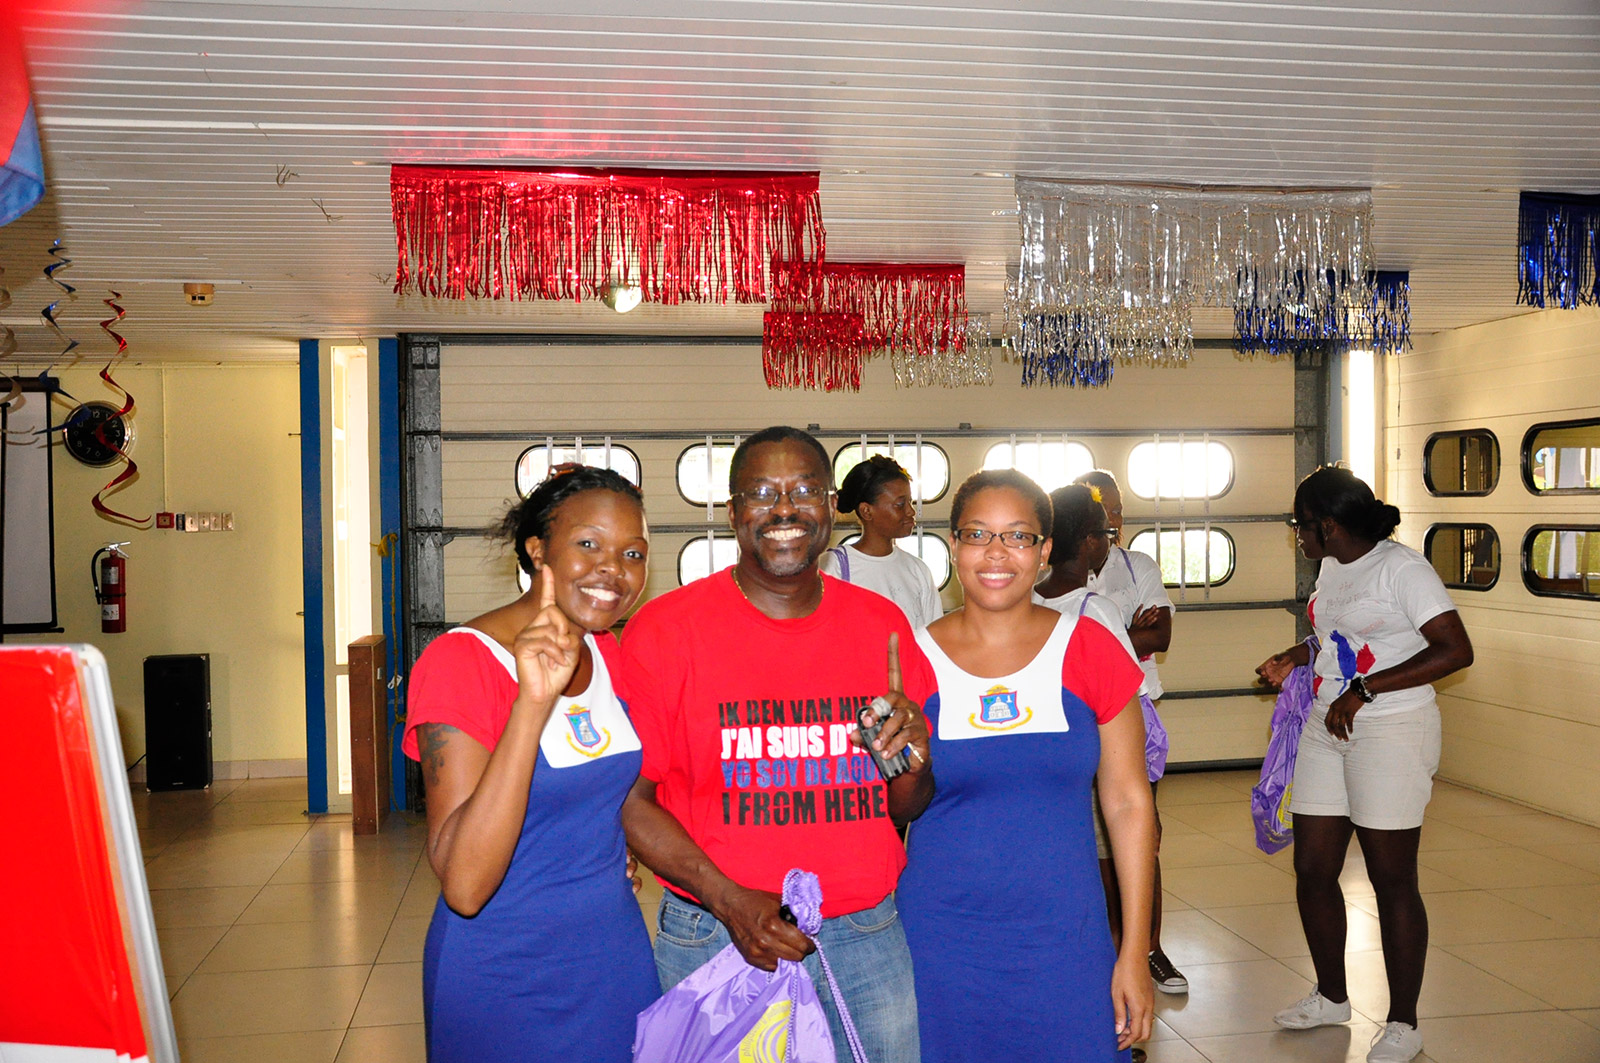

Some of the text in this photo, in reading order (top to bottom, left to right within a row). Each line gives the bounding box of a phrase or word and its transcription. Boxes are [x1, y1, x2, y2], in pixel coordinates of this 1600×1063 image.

[718, 701, 741, 727] IK
[746, 698, 786, 726] BEN
[789, 697, 833, 724] VAN
[721, 727, 762, 759] J'AI
[766, 725, 825, 759] SUIS
[721, 755, 884, 789] YO SOY DE AQU
[721, 784, 886, 826] I FROM HERE
